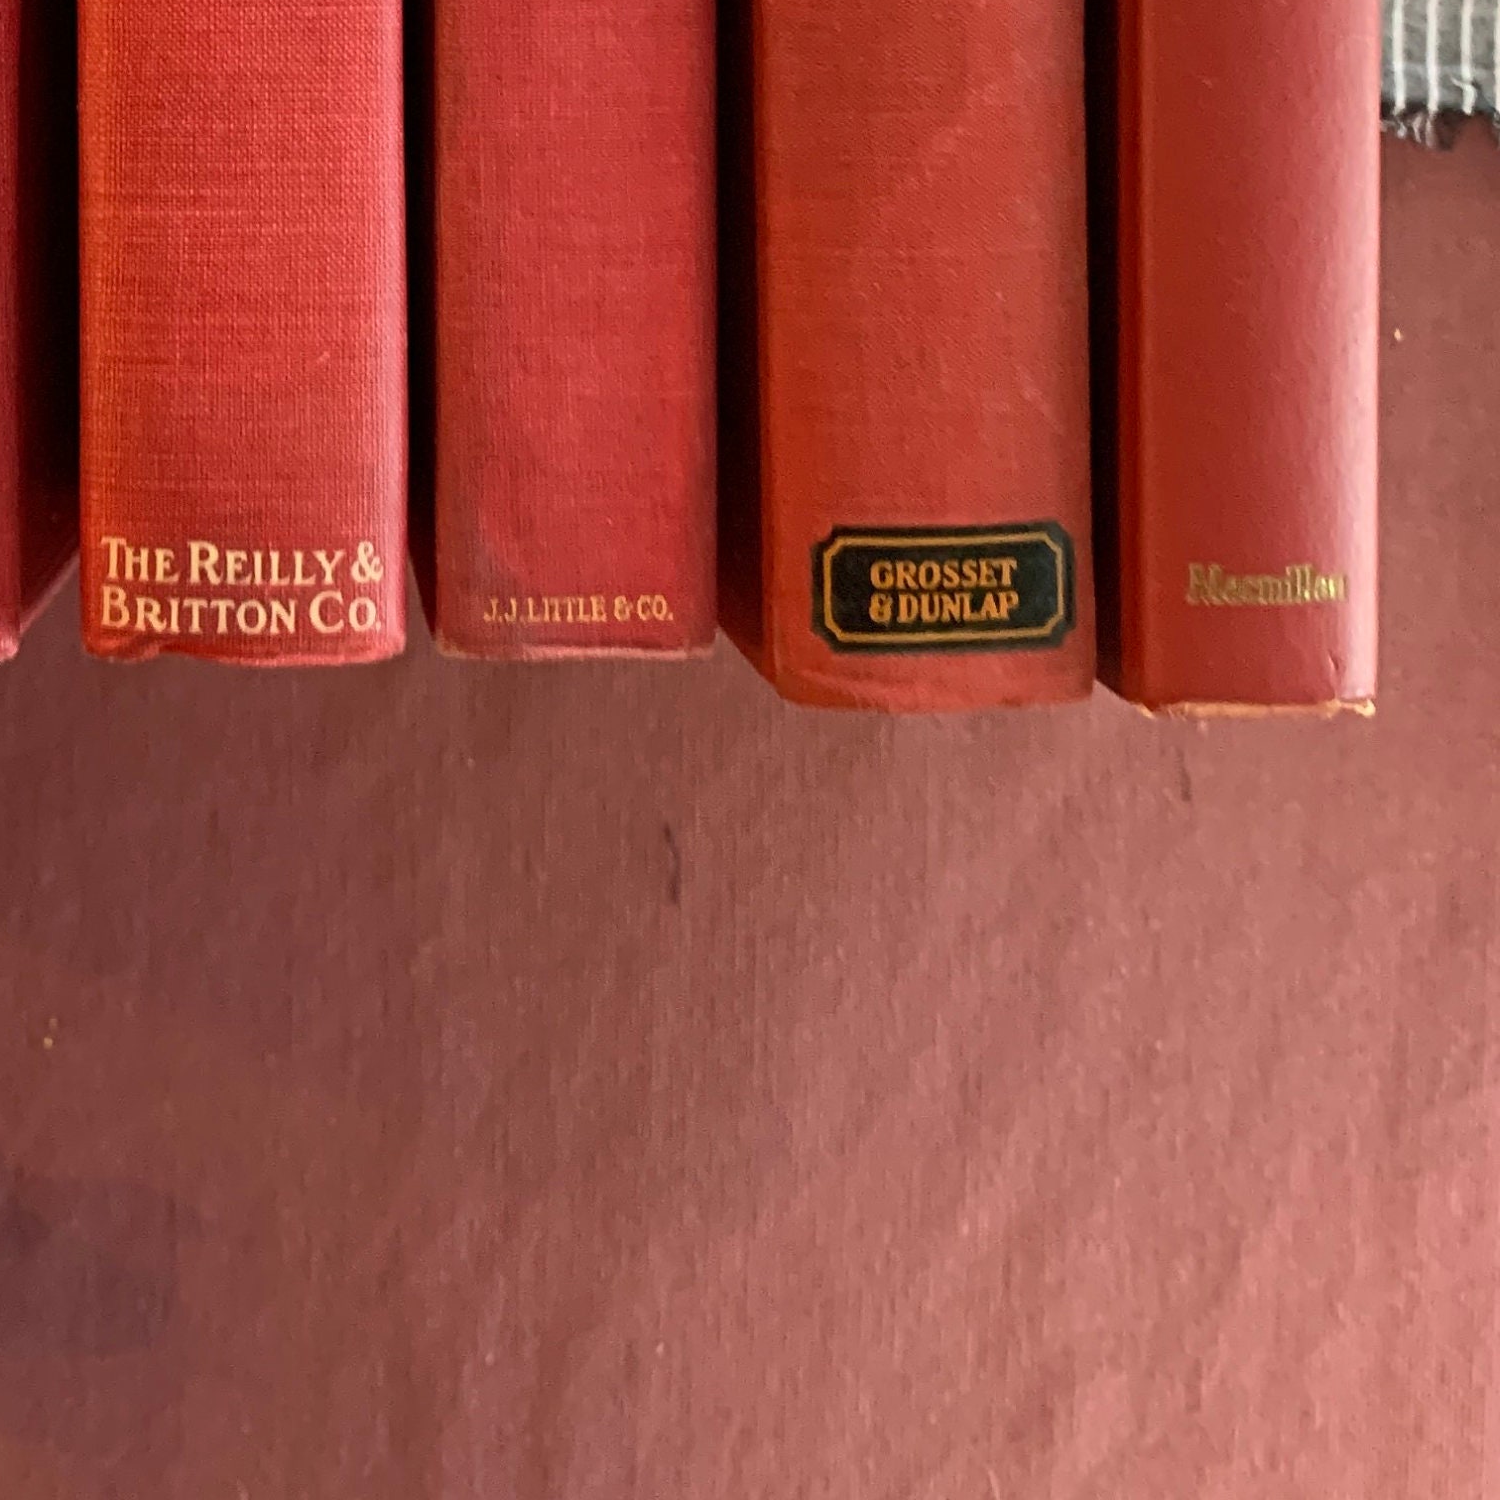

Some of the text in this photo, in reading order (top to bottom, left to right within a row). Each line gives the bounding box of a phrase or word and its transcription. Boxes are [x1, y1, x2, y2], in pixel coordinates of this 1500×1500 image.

[350, 541, 384, 584] &
[870, 558, 1018, 590] GROSSET
[1186, 562, 1347, 606] Macmillan
[527, 595, 607, 623] LITTLE
[614, 595, 633, 622] &
[637, 594, 673, 621] CO.
[869, 591, 1020, 625] & DUNLAP
